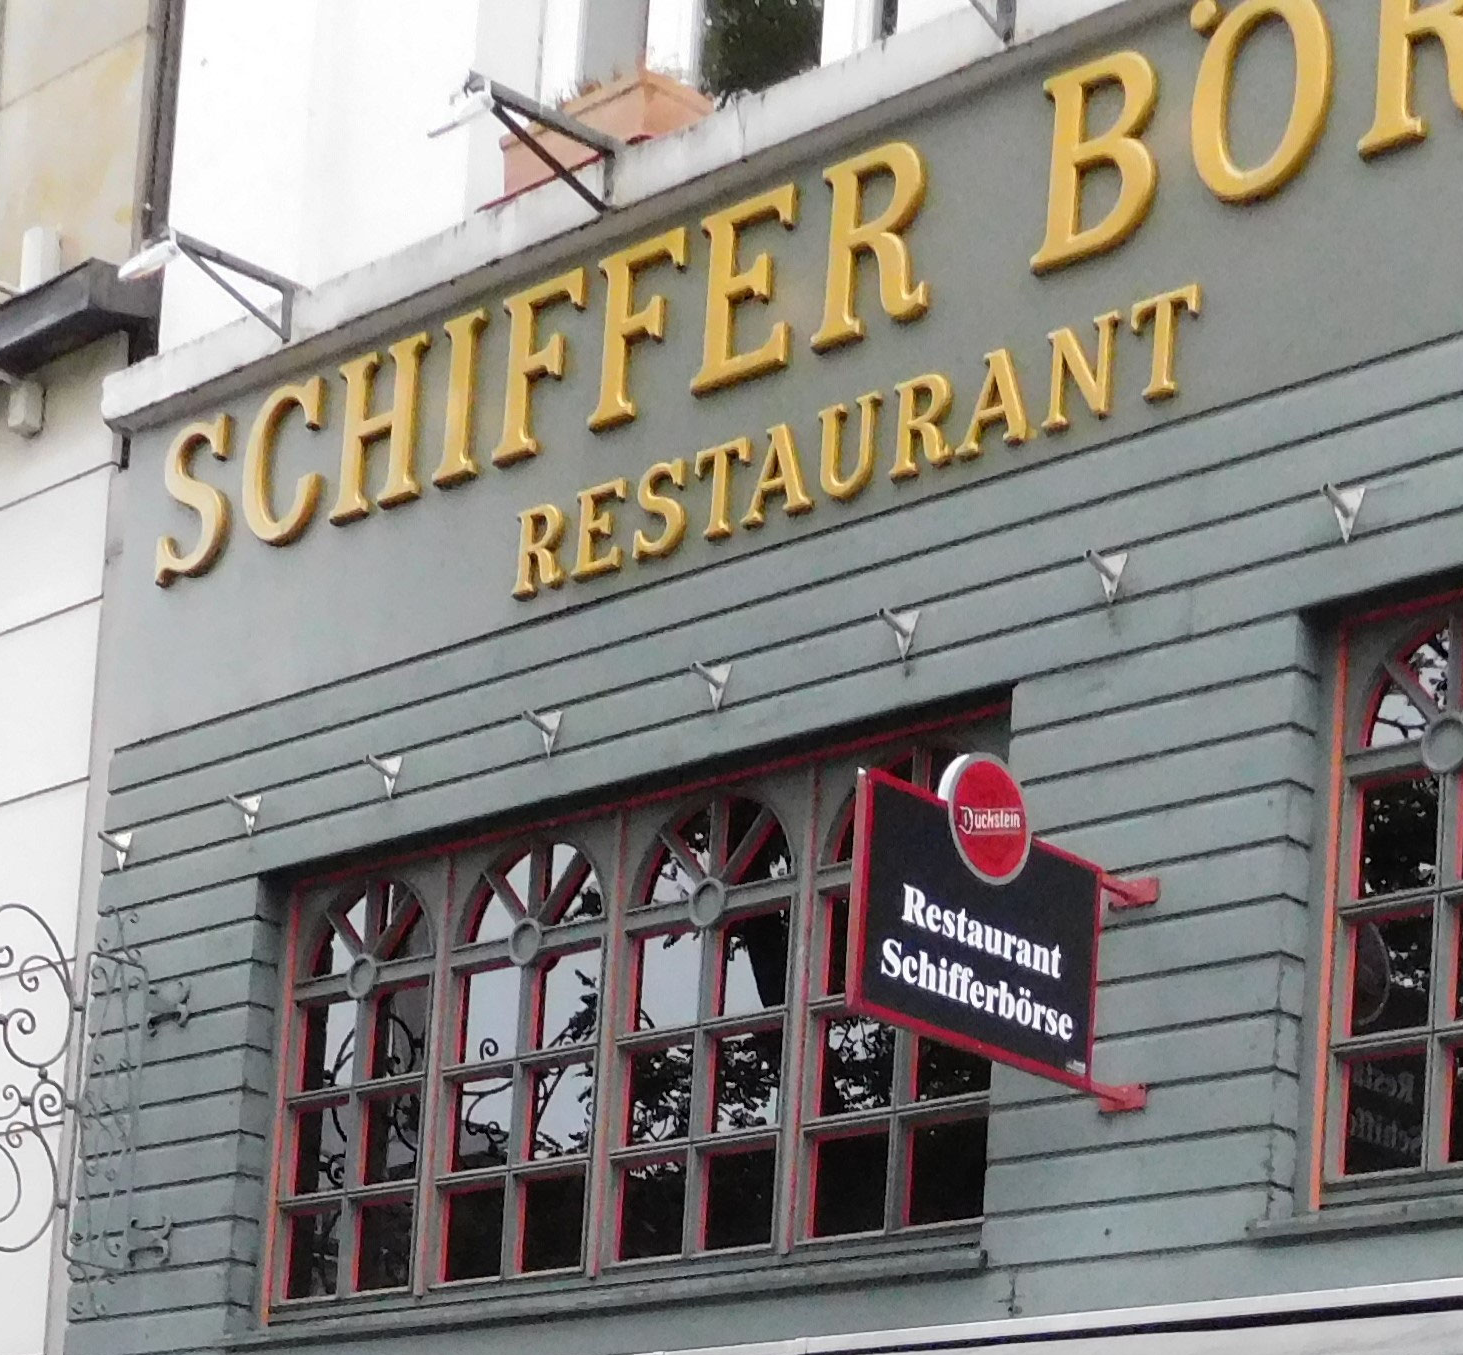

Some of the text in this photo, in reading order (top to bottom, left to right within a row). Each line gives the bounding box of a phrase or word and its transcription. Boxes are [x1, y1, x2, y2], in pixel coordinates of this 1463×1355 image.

[155, 141, 928, 588] SCHIFFER
[511, 283, 1202, 600] RESTAURANT
[959, 805, 1021, 835] Duckstein
[901, 882, 1062, 979] Restaurant
[880, 938, 1074, 1041] Schifferbörse
